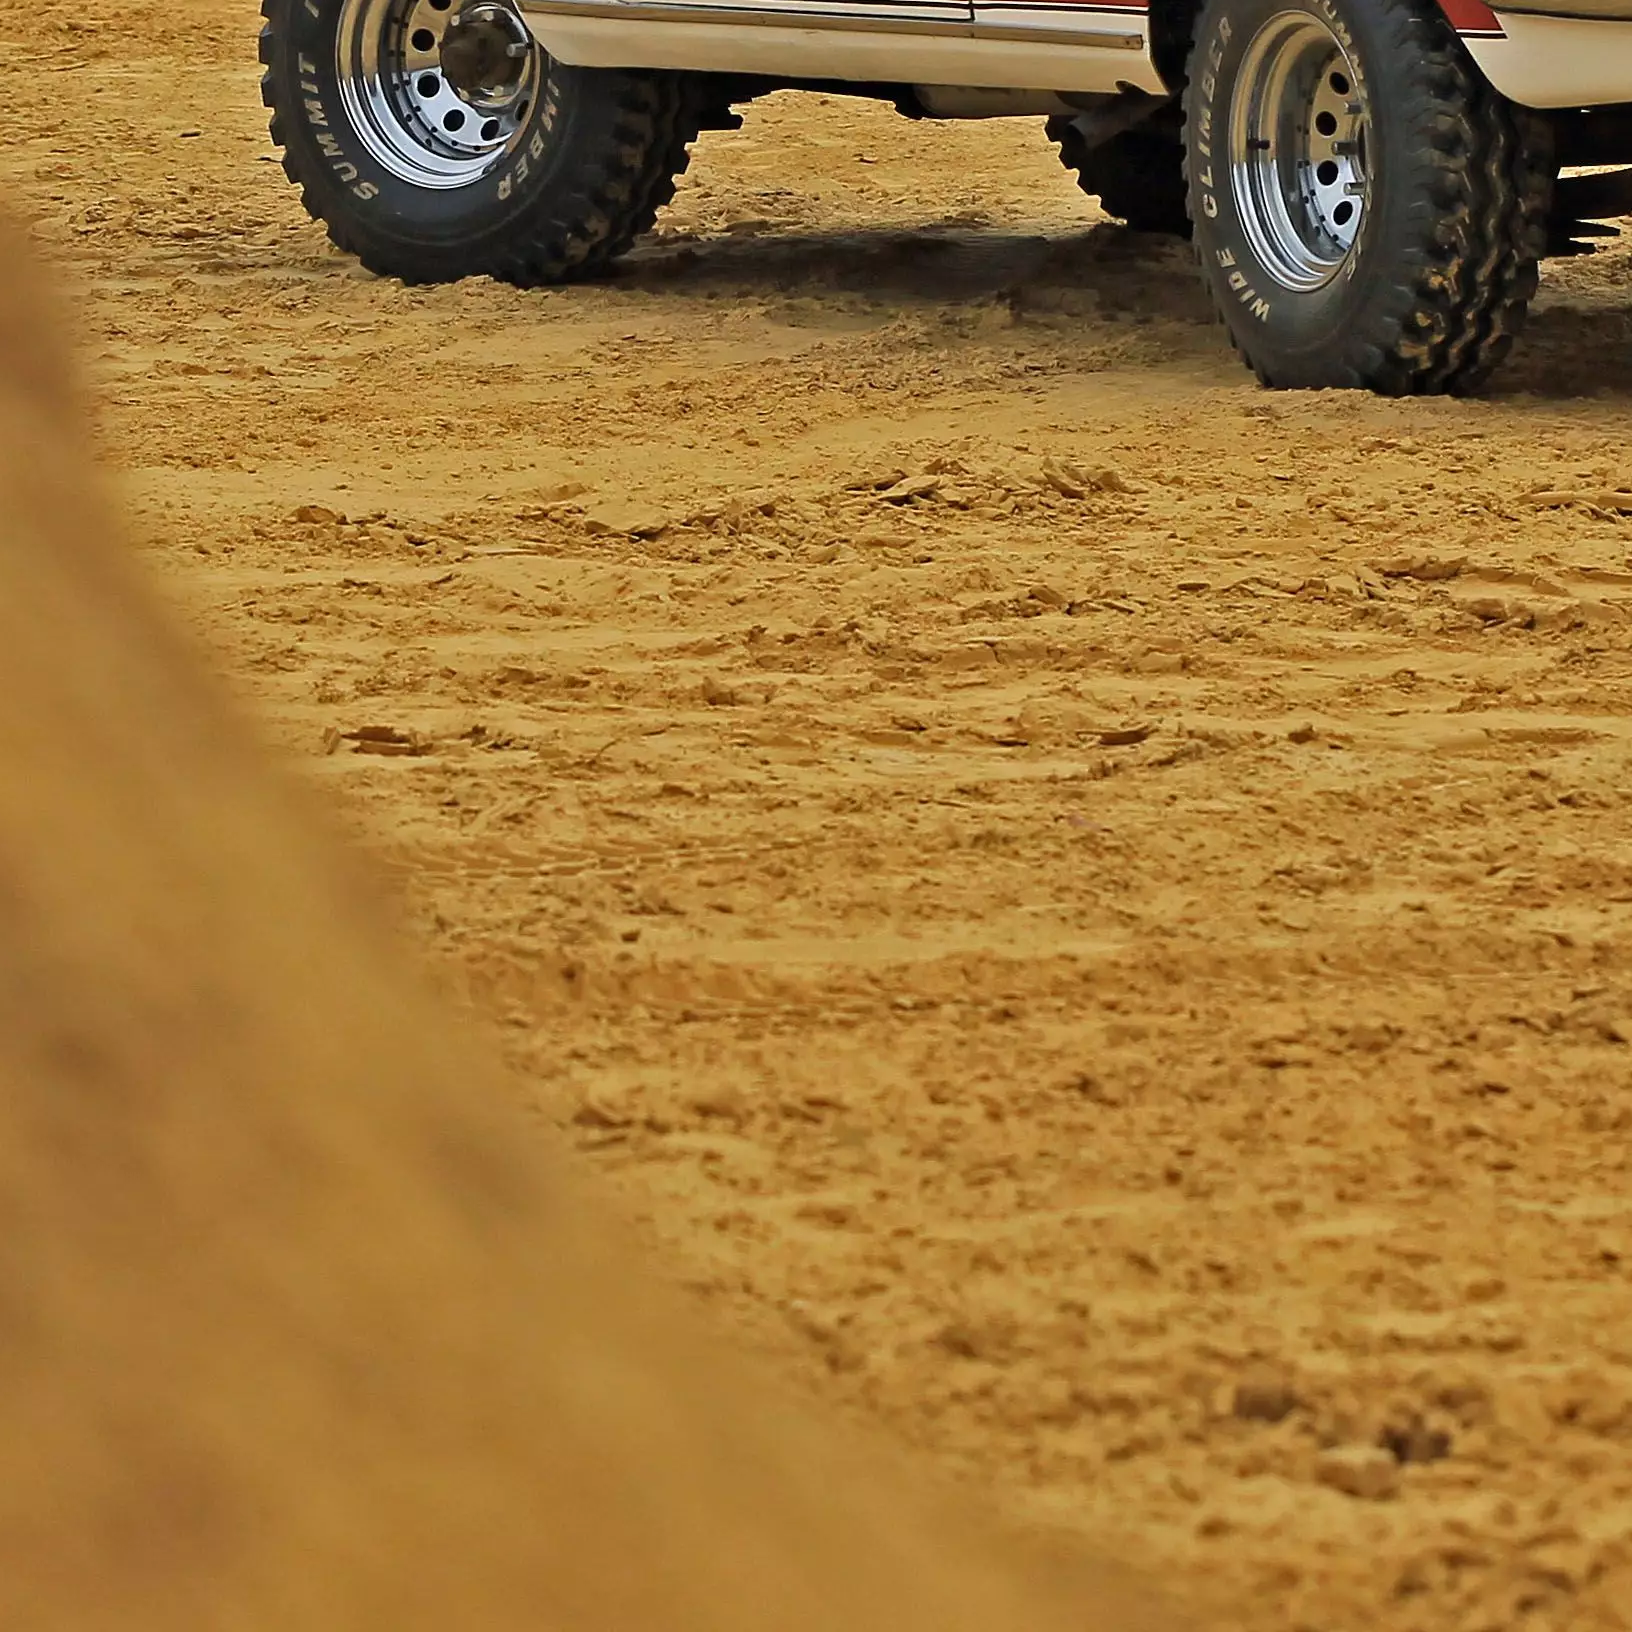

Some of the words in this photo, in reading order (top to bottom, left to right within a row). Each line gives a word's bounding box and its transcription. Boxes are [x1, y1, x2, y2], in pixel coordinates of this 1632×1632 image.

[297, 51, 379, 201] SUMMIT
[1198, 15, 1233, 219] CLIMBER
[1216, 247, 1271, 323] WIDE
